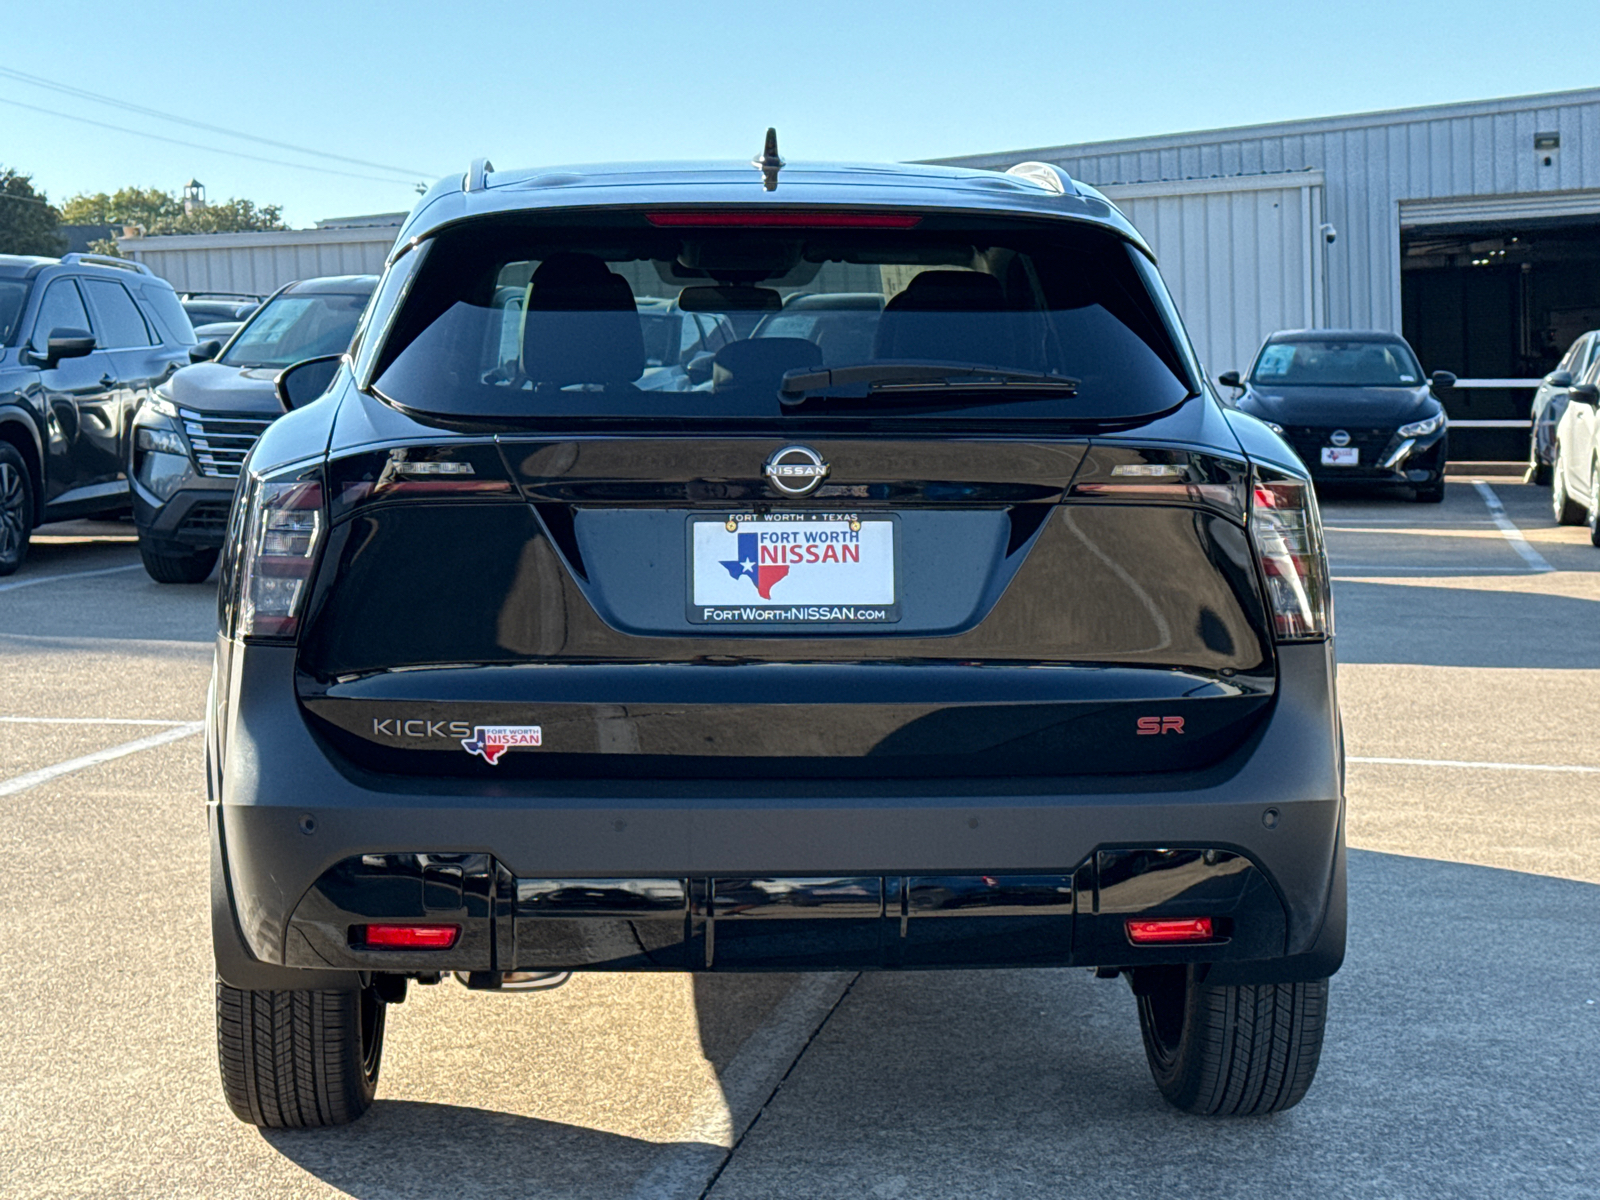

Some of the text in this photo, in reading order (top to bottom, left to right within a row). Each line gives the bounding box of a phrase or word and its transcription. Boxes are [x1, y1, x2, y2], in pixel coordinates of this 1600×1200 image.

[767, 467, 825, 475] NISSAN
[822, 513, 858, 521] TEXAS
[760, 531, 859, 543] FORT WORTH
[760, 544, 860, 564] NISSAN
[373, 718, 471, 738] KICKS
[1136, 716, 1185, 735] SR
[487, 735, 540, 744] NISSAN
